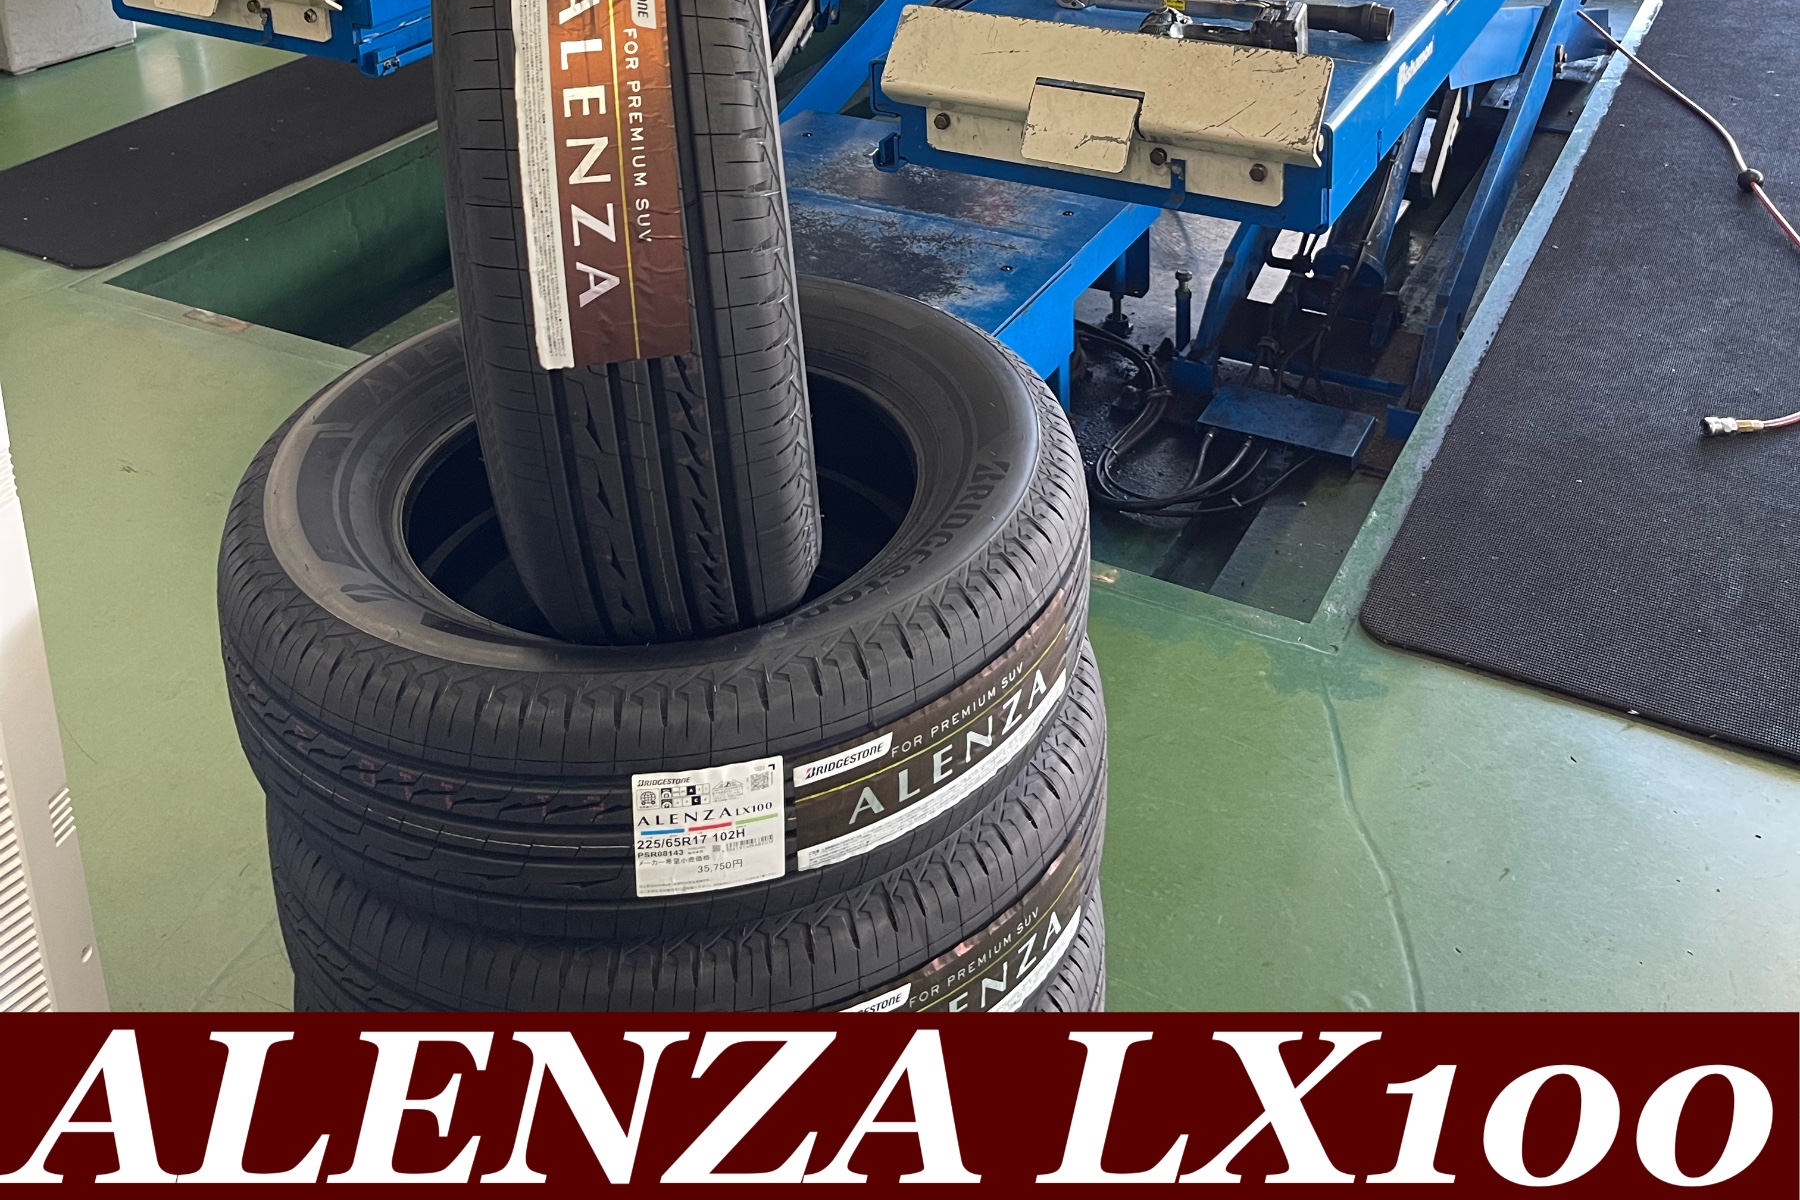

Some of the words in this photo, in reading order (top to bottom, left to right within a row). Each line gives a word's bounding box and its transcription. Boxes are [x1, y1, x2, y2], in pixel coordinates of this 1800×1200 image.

[622, 27, 639, 70] FOR
[626, 80, 647, 187] PREMIUM
[634, 198, 652, 243] SUV
[891, 734, 923, 758] FOR
[930, 688, 996, 739] PREMIUM
[1001, 661, 1024, 689] SUV
[804, 742, 884, 780] BRIDGESTONE
[848, 668, 1048, 825] ALENZA
[637, 777, 691, 787] BRIDGESTONE
[637, 807, 732, 827] ALENZA
[735, 802, 773, 816] LX100
[637, 834, 707, 850] 225/65R17
[712, 829, 745, 842] 102H
[637, 850, 684, 859] PSR08143
[639, 855, 710, 866] メーカー希望小売価格
[697, 859, 743, 874] 35,750円
[909, 984, 940, 1008] FOR
[947, 932, 1012, 987] PREMIUM
[1016, 906, 1039, 935] SUV
